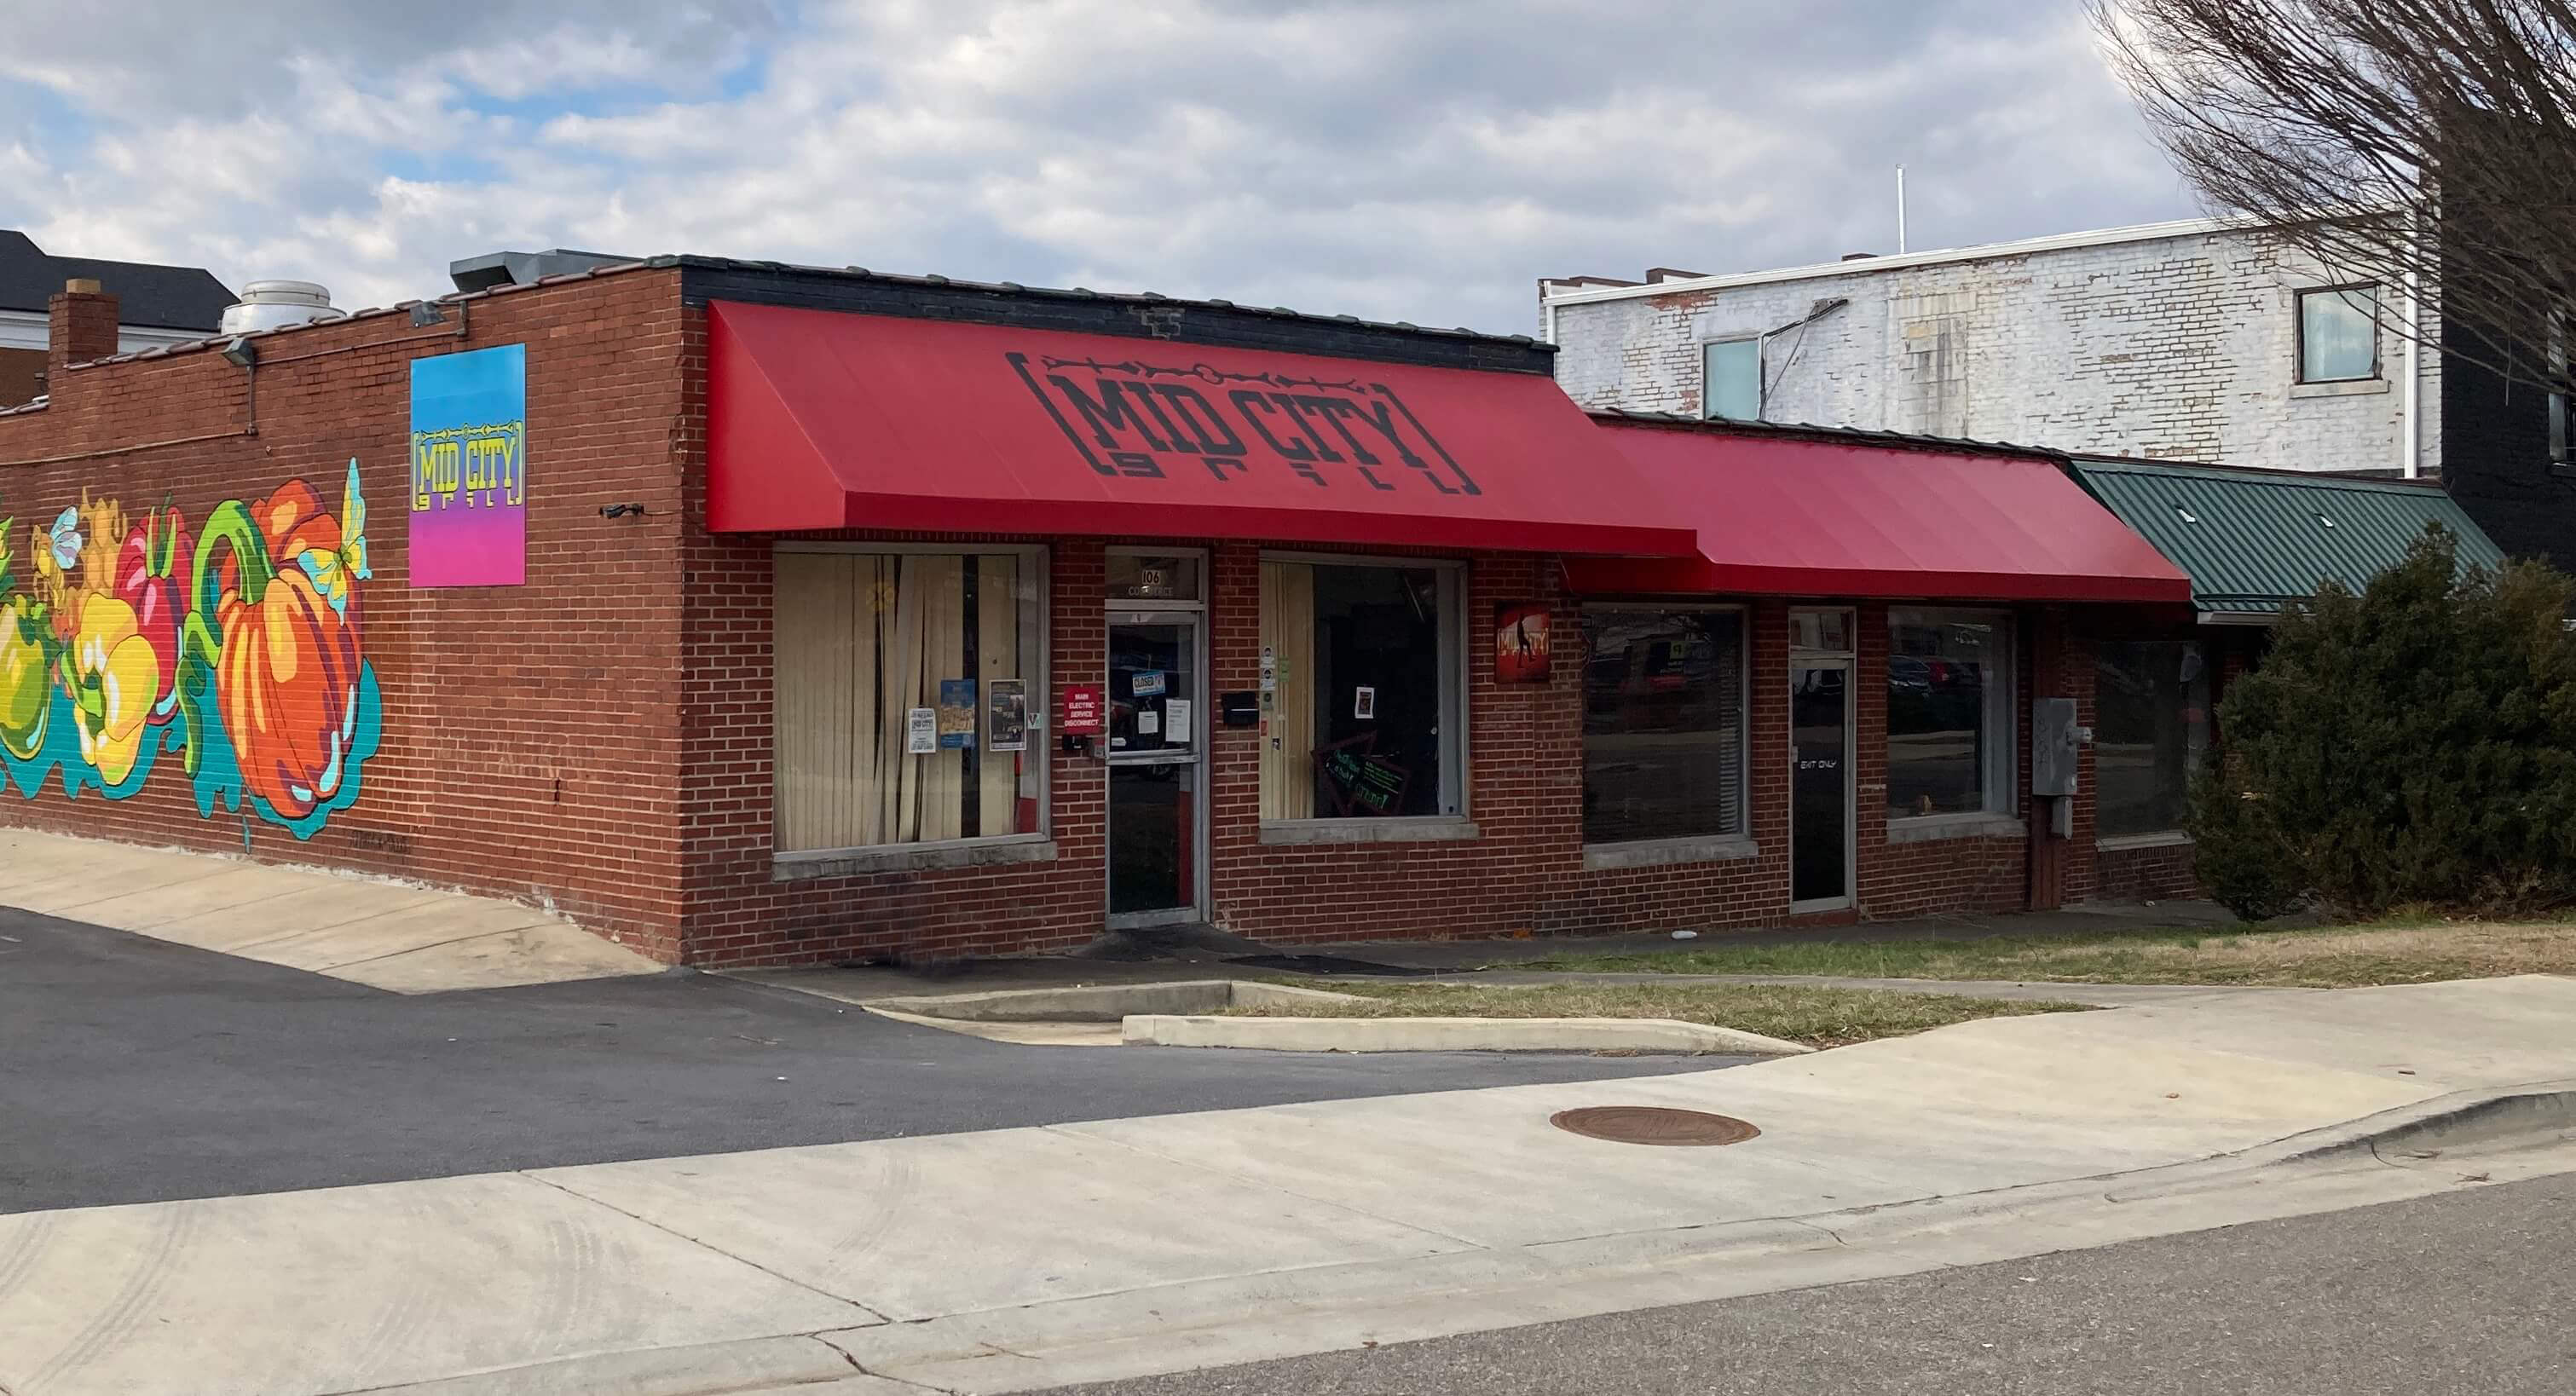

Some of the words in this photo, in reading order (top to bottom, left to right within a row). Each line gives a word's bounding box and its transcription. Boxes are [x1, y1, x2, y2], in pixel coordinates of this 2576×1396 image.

[1046, 374, 1248, 456] MID
[1227, 389, 1430, 469] CITY
[419, 441, 459, 493] MID
[465, 436, 516, 492] CITY
[1142, 570, 1160, 584] 106
[1134, 675, 1154, 688] CLOSED
[1064, 718, 1100, 727] DISCONNECT
[1800, 760, 1817, 770] EXIT
[1818, 759, 1838, 769] ONLY
